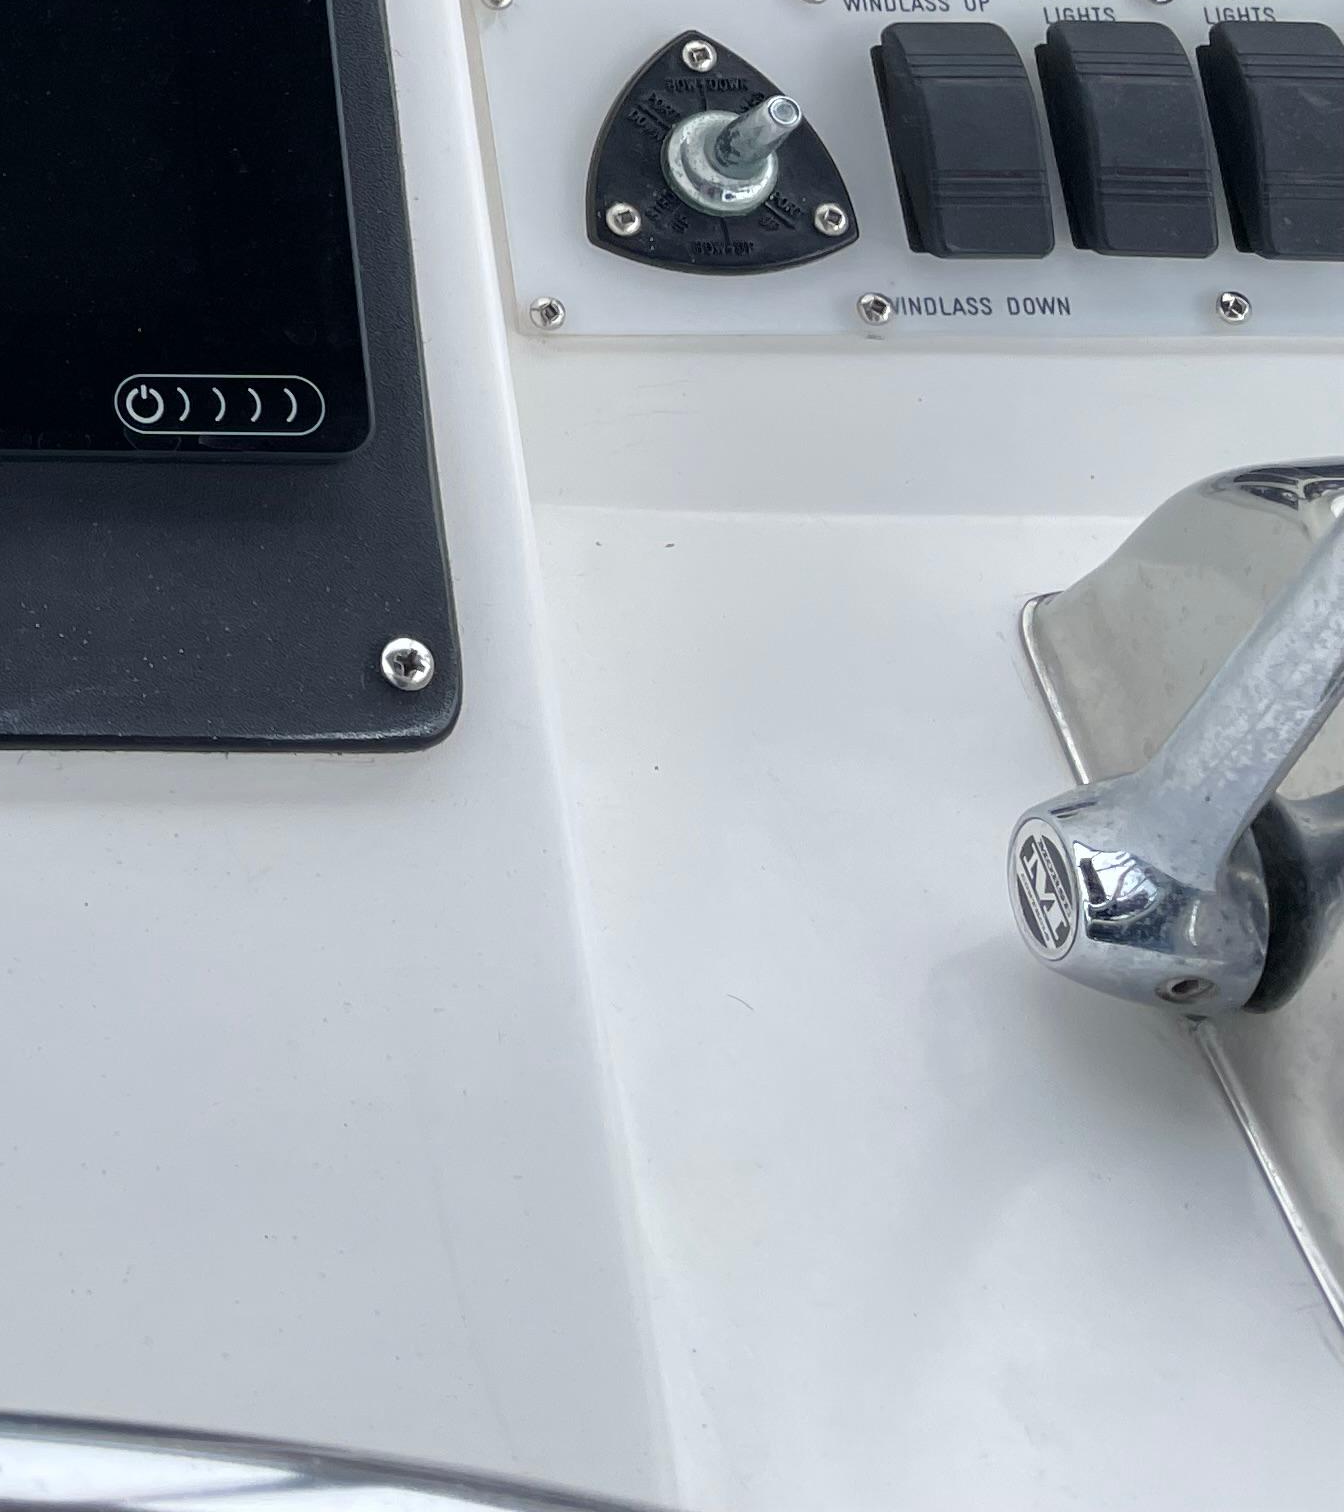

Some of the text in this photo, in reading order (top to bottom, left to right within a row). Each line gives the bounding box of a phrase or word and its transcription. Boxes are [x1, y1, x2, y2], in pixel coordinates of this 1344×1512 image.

[1043, 6, 1116, 25] LIGHTS
[1203, 6, 1277, 25] LIGHTS
[1007, 296, 1072, 316] DOWN
